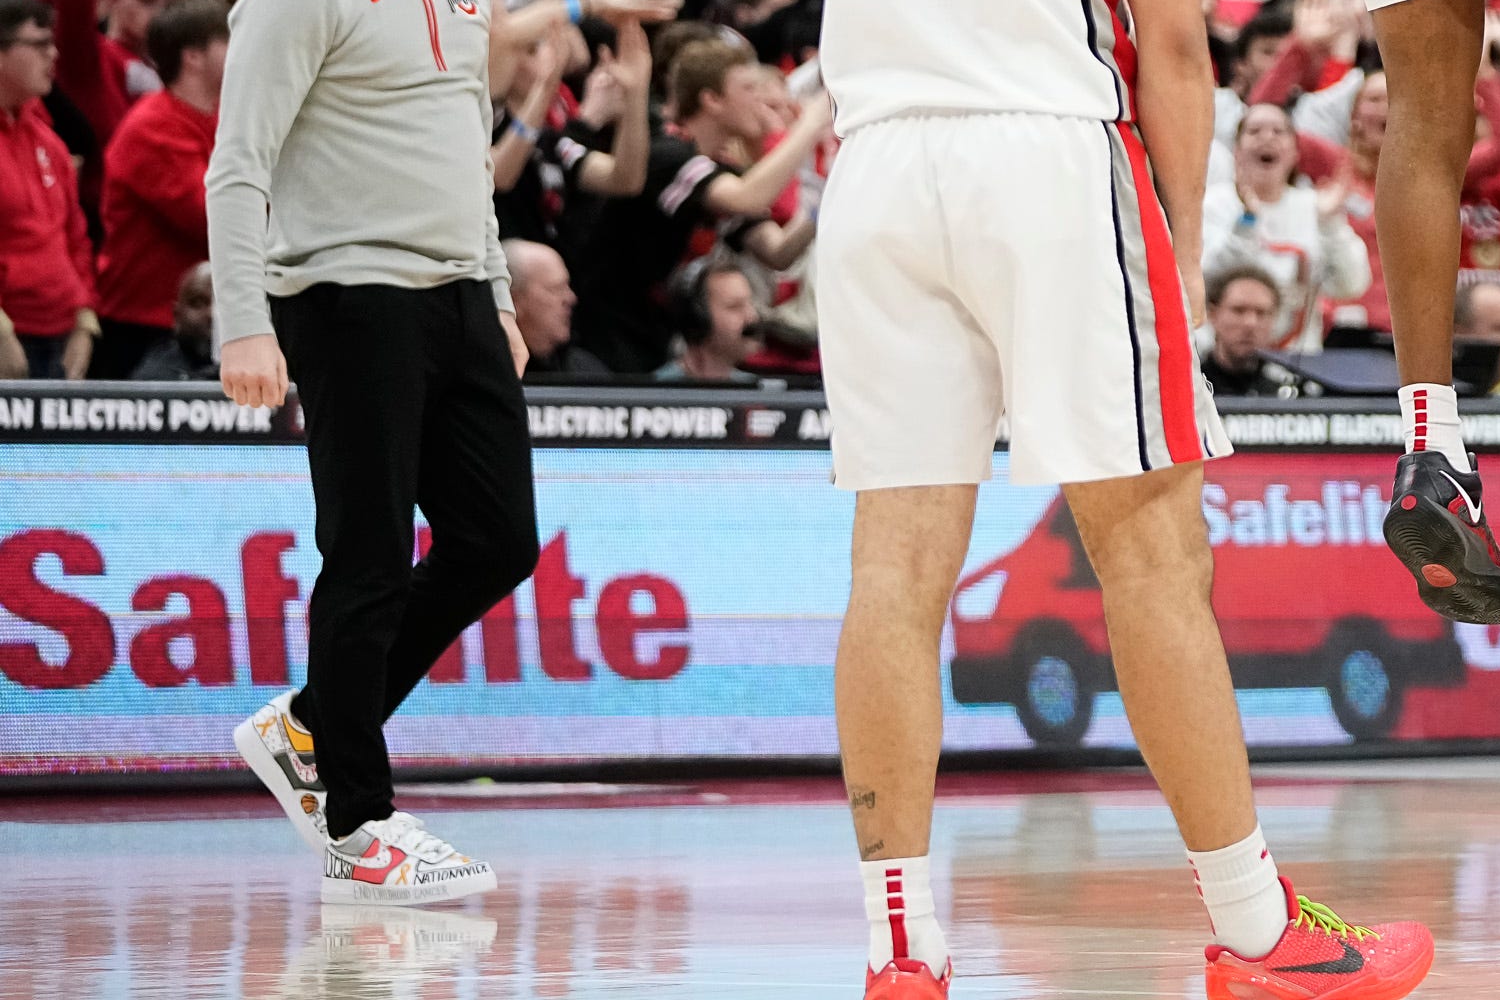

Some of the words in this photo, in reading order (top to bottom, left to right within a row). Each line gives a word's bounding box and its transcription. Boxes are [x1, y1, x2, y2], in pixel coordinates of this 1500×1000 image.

[40, 398, 165, 432] ELECTRIC
[168, 398, 272, 432] POWER
[527, 405, 629, 439] LECTRIC
[631, 406, 728, 439] POWER
[1202, 480, 1396, 547] Safelit
[414, 863, 488, 886] NATIONWIDE
